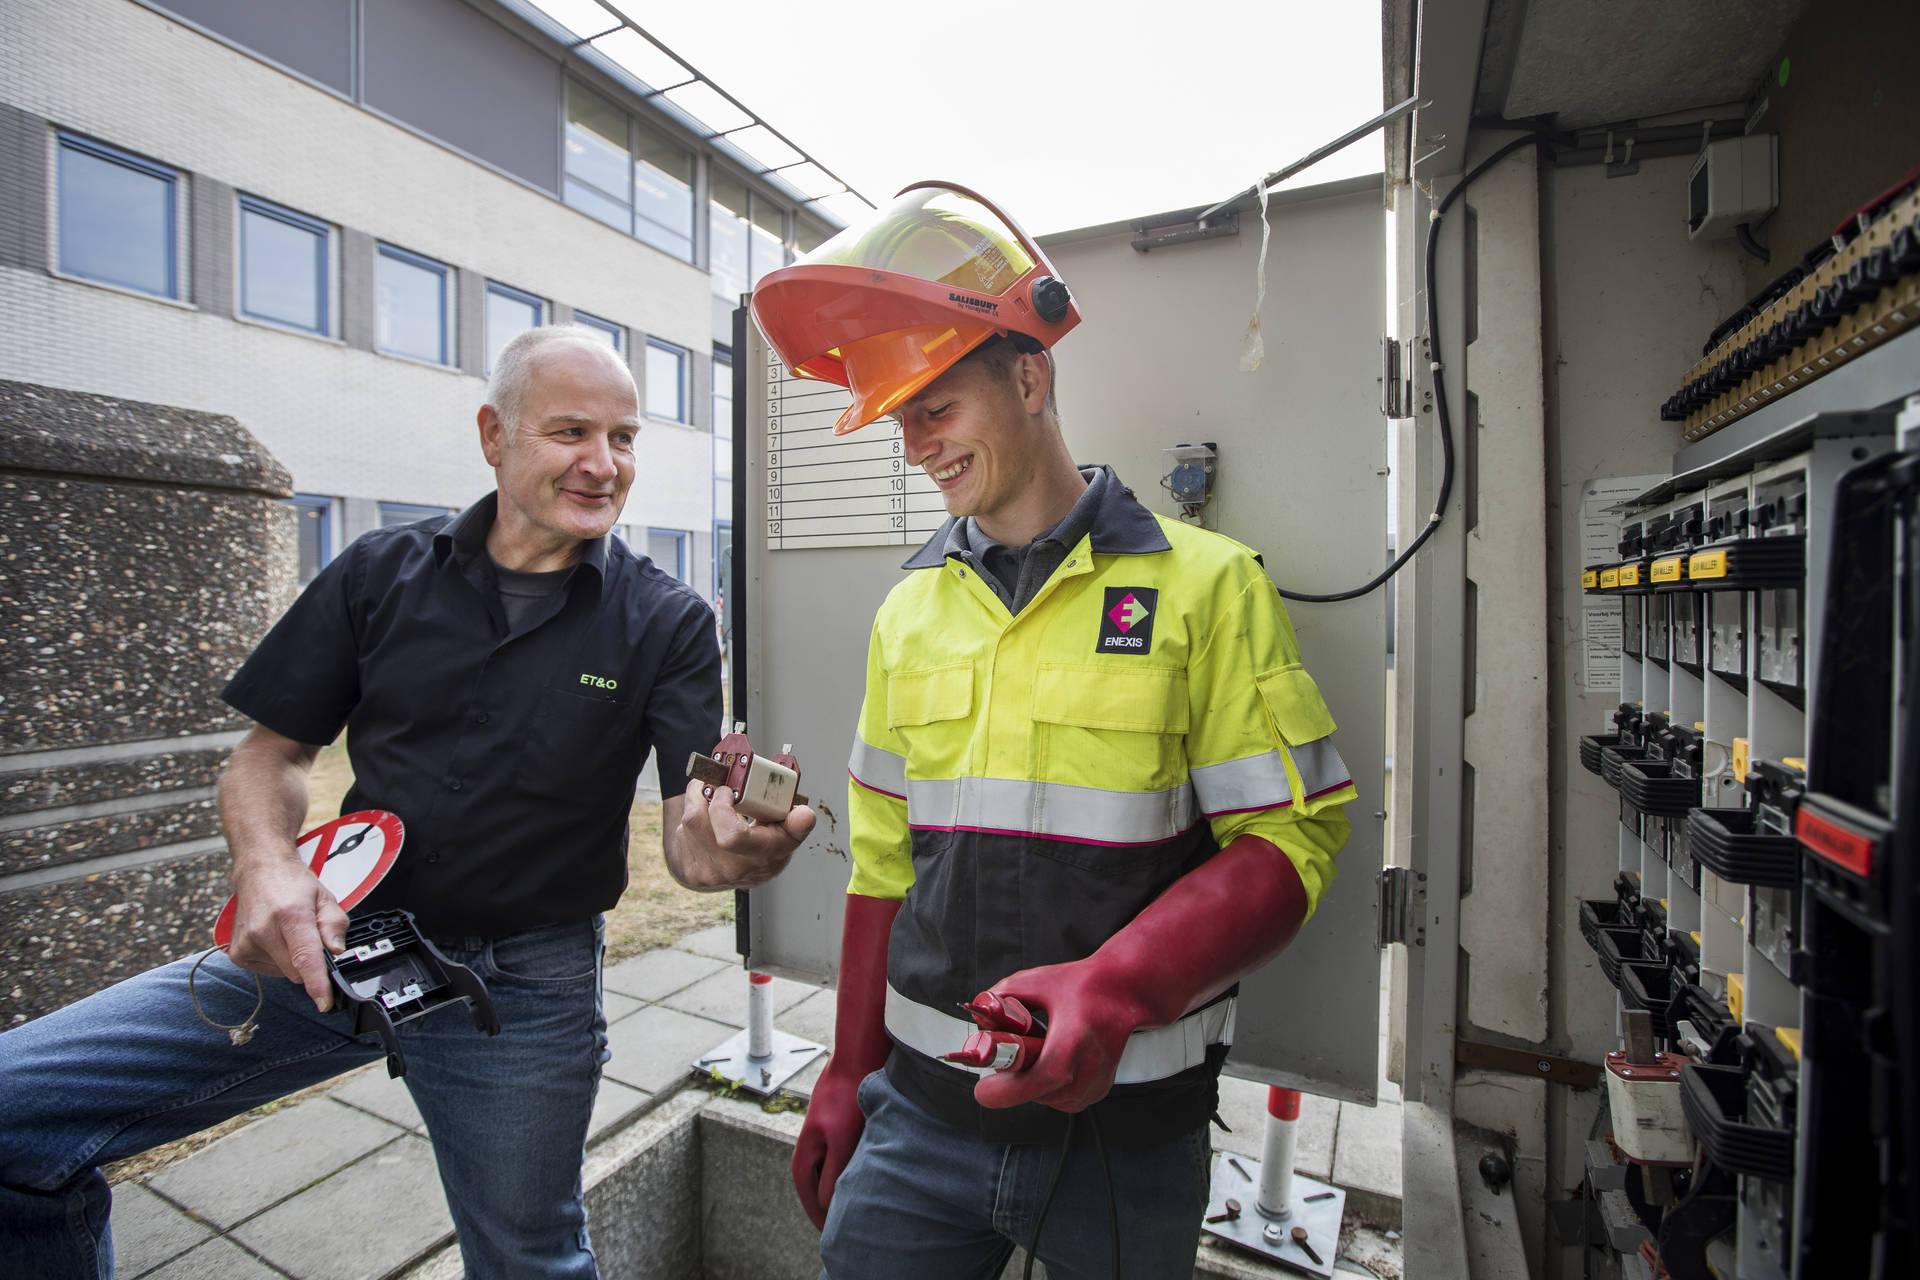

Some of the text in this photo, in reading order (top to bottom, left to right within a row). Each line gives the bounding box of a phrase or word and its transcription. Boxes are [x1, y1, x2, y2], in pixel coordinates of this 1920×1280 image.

[949, 293, 998, 310] SALISBURY
[770, 367, 778, 379] 3
[770, 385, 778, 396] 4
[770, 402, 778, 413] 5
[770, 419, 778, 430] 6
[893, 423, 900, 435] 7
[770, 437, 778, 448] 7
[892, 442, 900, 453] 8
[770, 454, 778, 465] 8
[892, 460, 900, 472] 9
[770, 471, 778, 482] 9
[891, 479, 903, 490] 10
[769, 488, 780, 500] 10
[891, 498, 901, 509] 11
[769, 506, 779, 516] 11
[891, 516, 903, 528] 12
[769, 522, 780, 534] 12
[1105, 636, 1143, 648] ENEXIS
[580, 673, 618, 690] ET&O
